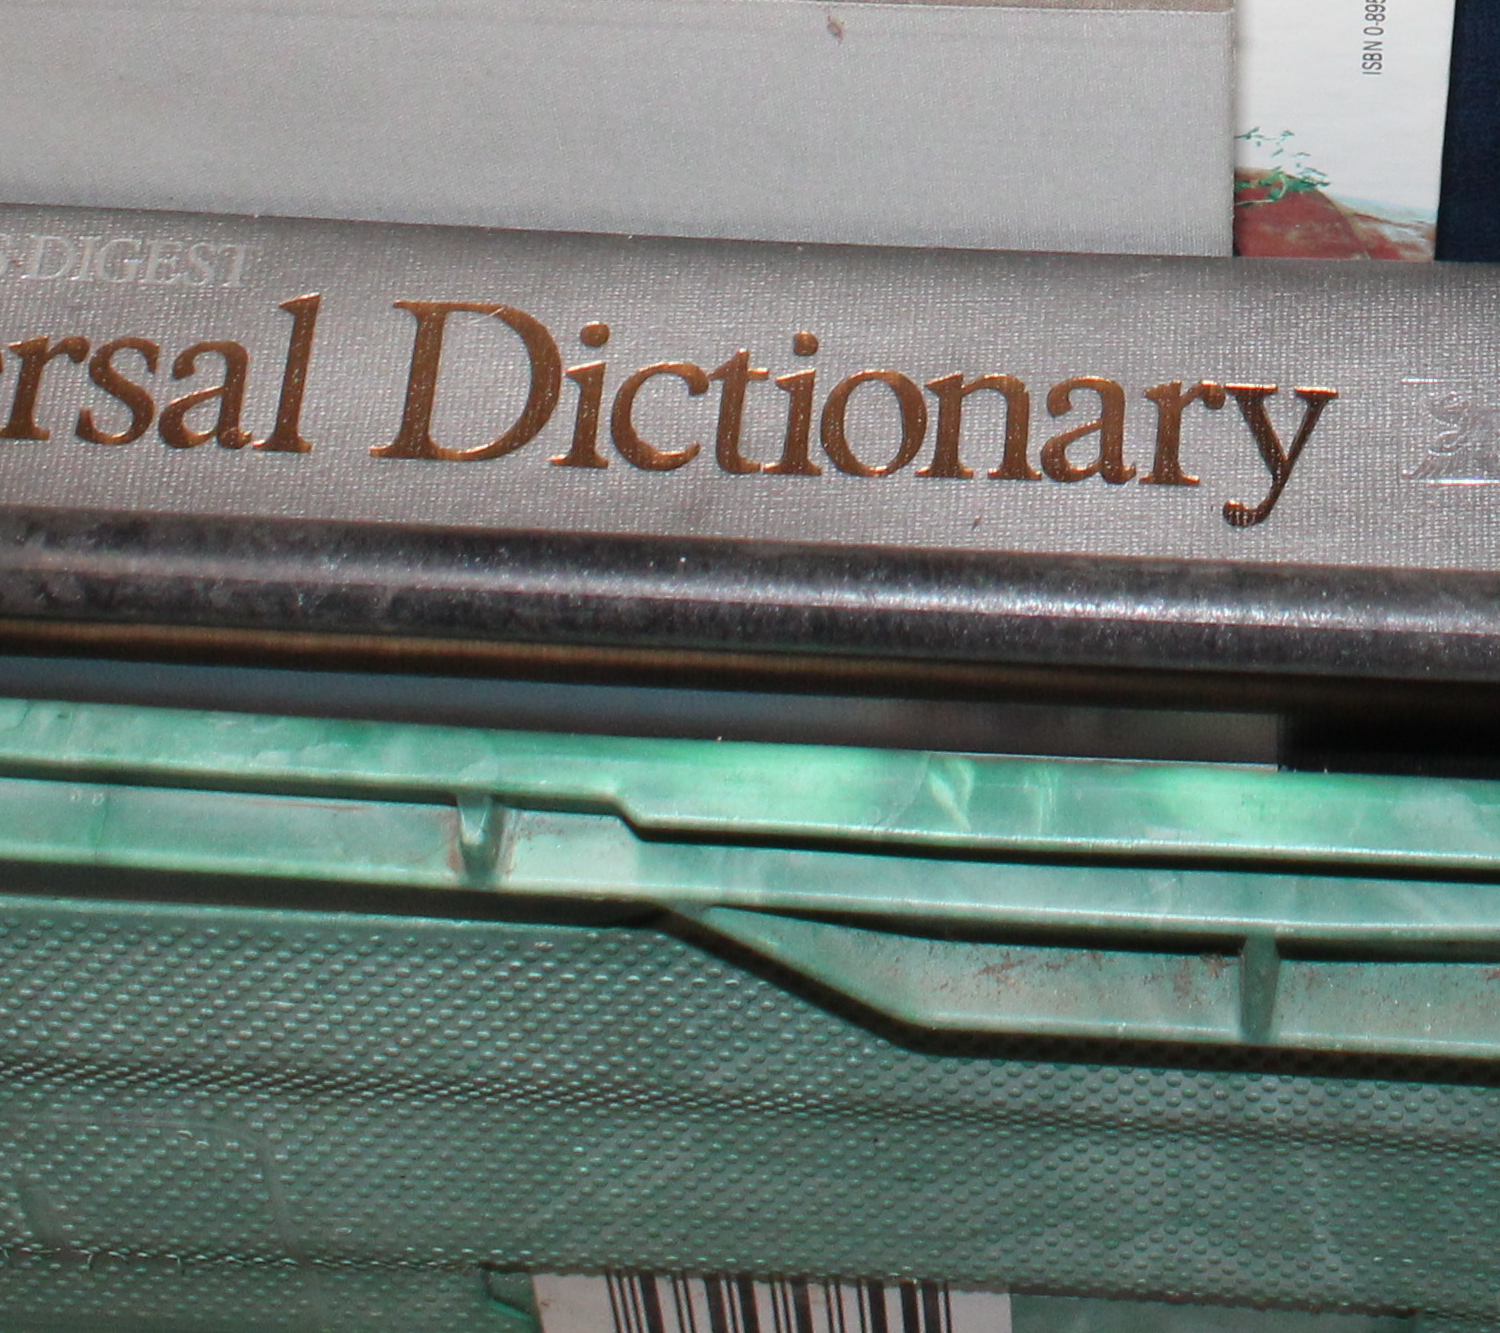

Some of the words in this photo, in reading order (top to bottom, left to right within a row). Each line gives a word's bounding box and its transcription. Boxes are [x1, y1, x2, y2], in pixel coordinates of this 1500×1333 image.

[1362, 39, 1384, 76] ISBN
[20, 232, 256, 289] DIGEST
[367, 298, 1340, 528] Dictionary
